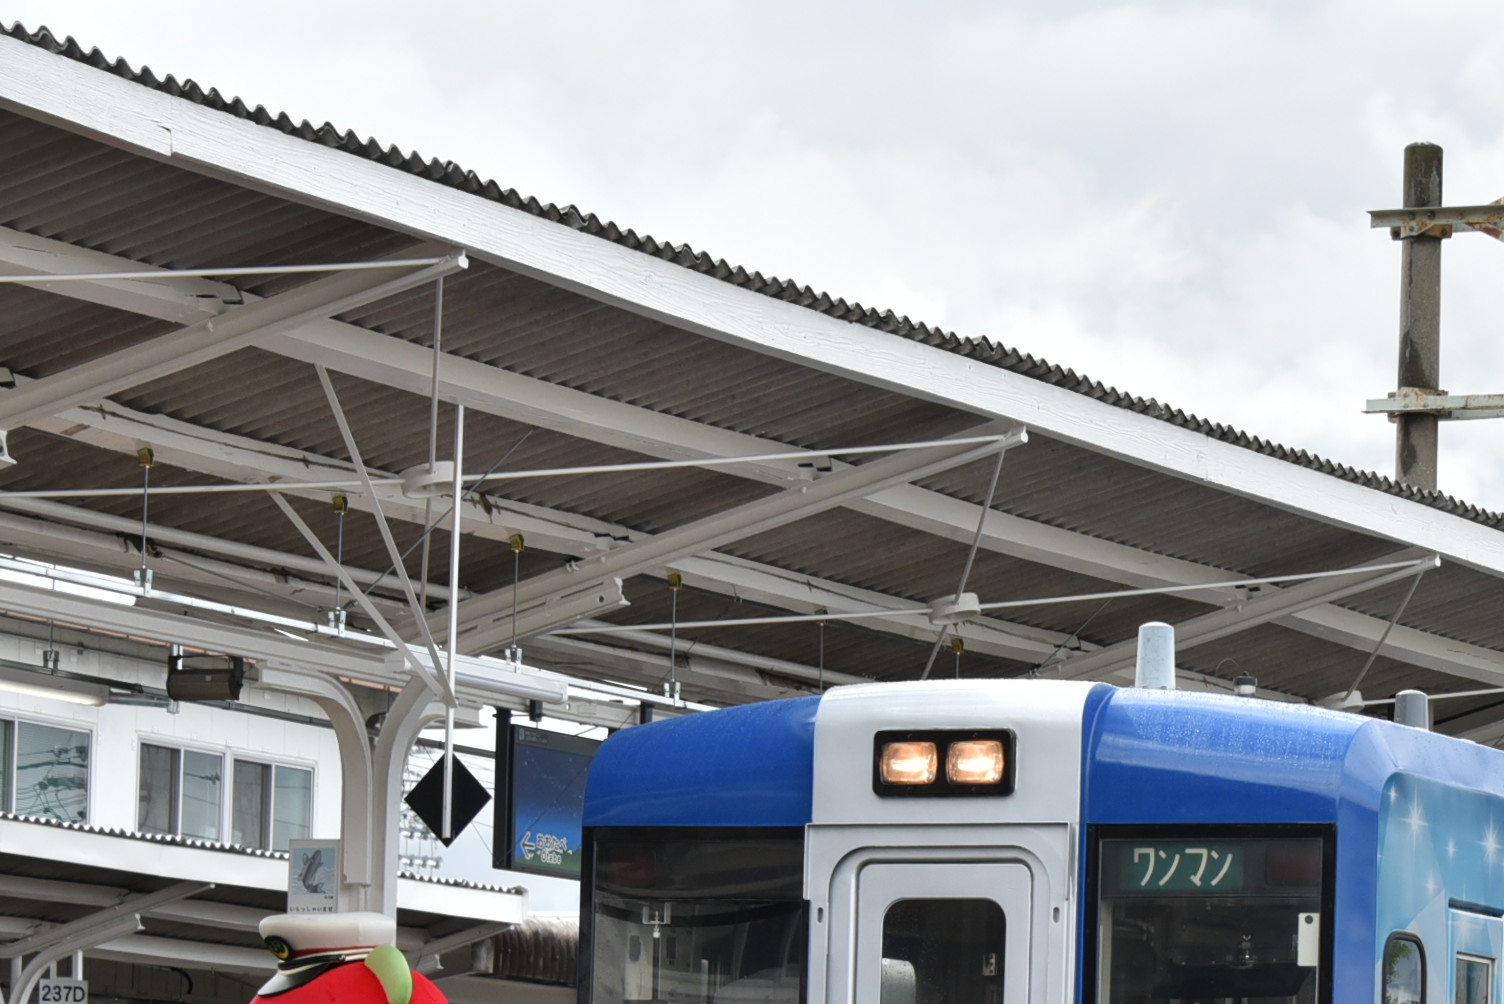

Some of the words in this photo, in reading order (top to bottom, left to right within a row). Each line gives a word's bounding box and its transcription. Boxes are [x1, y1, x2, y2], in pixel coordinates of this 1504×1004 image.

[1133, 847, 1233, 887] ワンマン
[41, 984, 86, 1003] 237D
